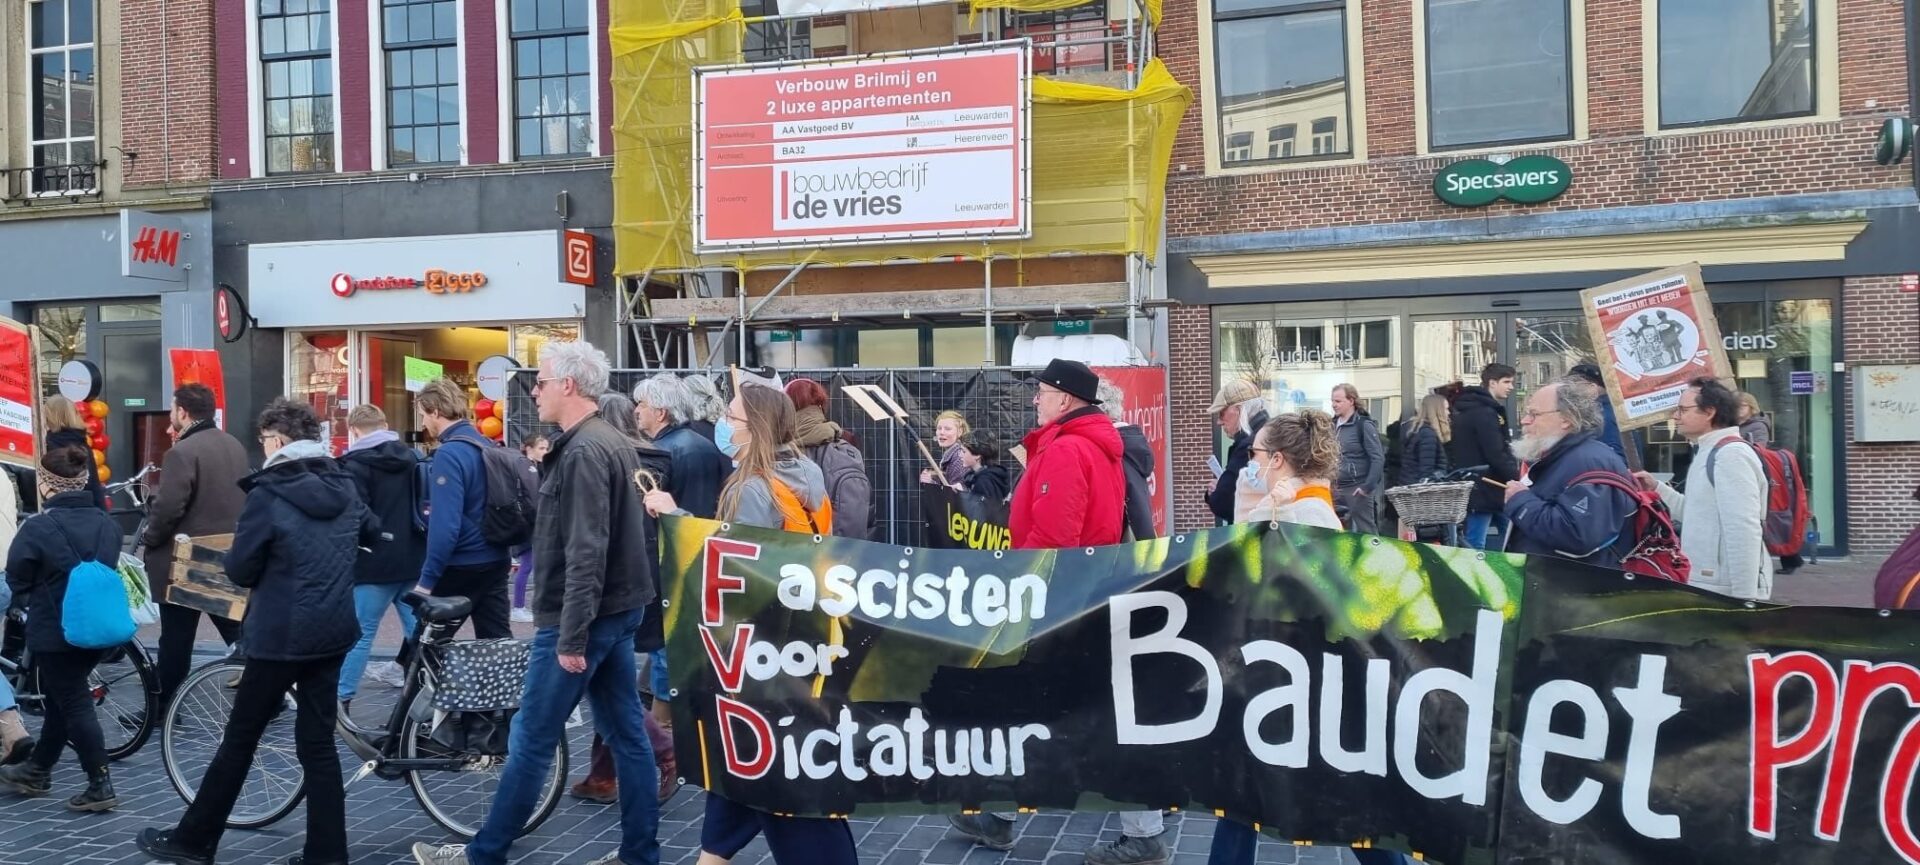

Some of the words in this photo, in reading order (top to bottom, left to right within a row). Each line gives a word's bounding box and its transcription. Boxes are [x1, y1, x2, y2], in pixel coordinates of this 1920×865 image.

[776, 78, 848, 94] Verbouw
[855, 70, 911, 88] Brilmij
[916, 71, 936, 83] en
[767, 101, 776, 115] 2
[782, 99, 816, 114] luxe
[821, 90, 952, 114] appartementen
[782, 126, 795, 135] AA
[798, 123, 839, 135] Vastgoed
[841, 122, 854, 131] BV
[954, 111, 1009, 122] Leeuwarden
[954, 132, 1009, 144] Heerenveen
[782, 146, 806, 155] BA32
[793, 162, 928, 193] bouwbedrijf
[1446, 170, 1559, 195] Specsavers
[793, 194, 827, 220] de
[834, 191, 902, 218] vries
[954, 202, 1009, 213] Leeuwarden
[132, 226, 179, 267] H&M
[356, 276, 416, 290] vodafone
[1722, 331, 1777, 351] ciens
[1269, 345, 1355, 364] Audiciens
[947, 502, 1012, 550] leeuwa
[699, 623, 849, 694] Voor
[1109, 590, 1683, 840] Baudet
[715, 694, 1052, 780] Dictatuur
